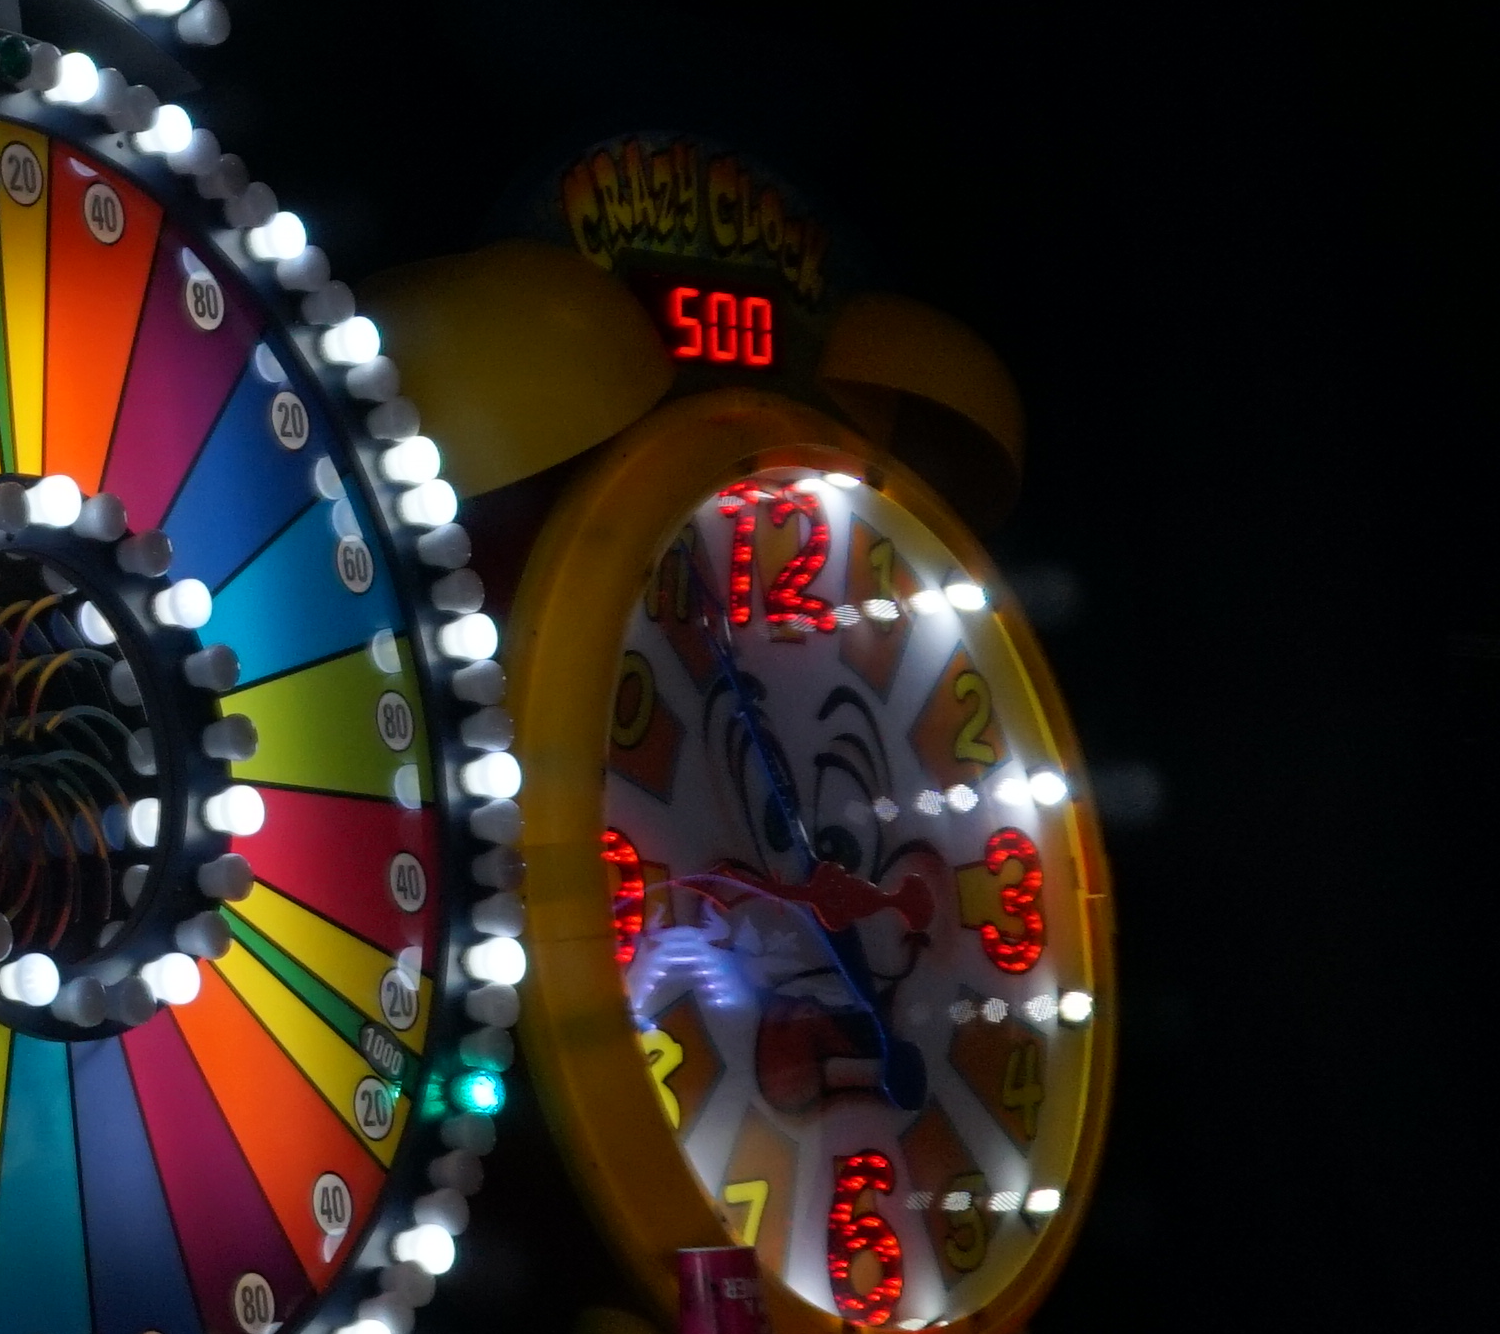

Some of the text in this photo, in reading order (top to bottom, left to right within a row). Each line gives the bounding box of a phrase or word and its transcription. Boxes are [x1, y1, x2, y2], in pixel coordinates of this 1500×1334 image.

[9, 156, 36, 192] 20
[90, 195, 117, 231] 40
[192, 284, 218, 319] 80
[671, 287, 772, 365] 500
[277, 403, 304, 438] 20
[345, 547, 367, 581] 60
[718, 480, 836, 632] 12
[384, 705, 406, 739] 80
[955, 670, 998, 765] 2
[396, 866, 420, 899] 40
[982, 827, 1043, 974] 3
[366, 1027, 404, 1075] 1000
[361, 1090, 387, 1126] 20
[321, 1187, 344, 1222] 40
[829, 1150, 902, 1326] 6
[241, 1287, 267, 1323] 80
